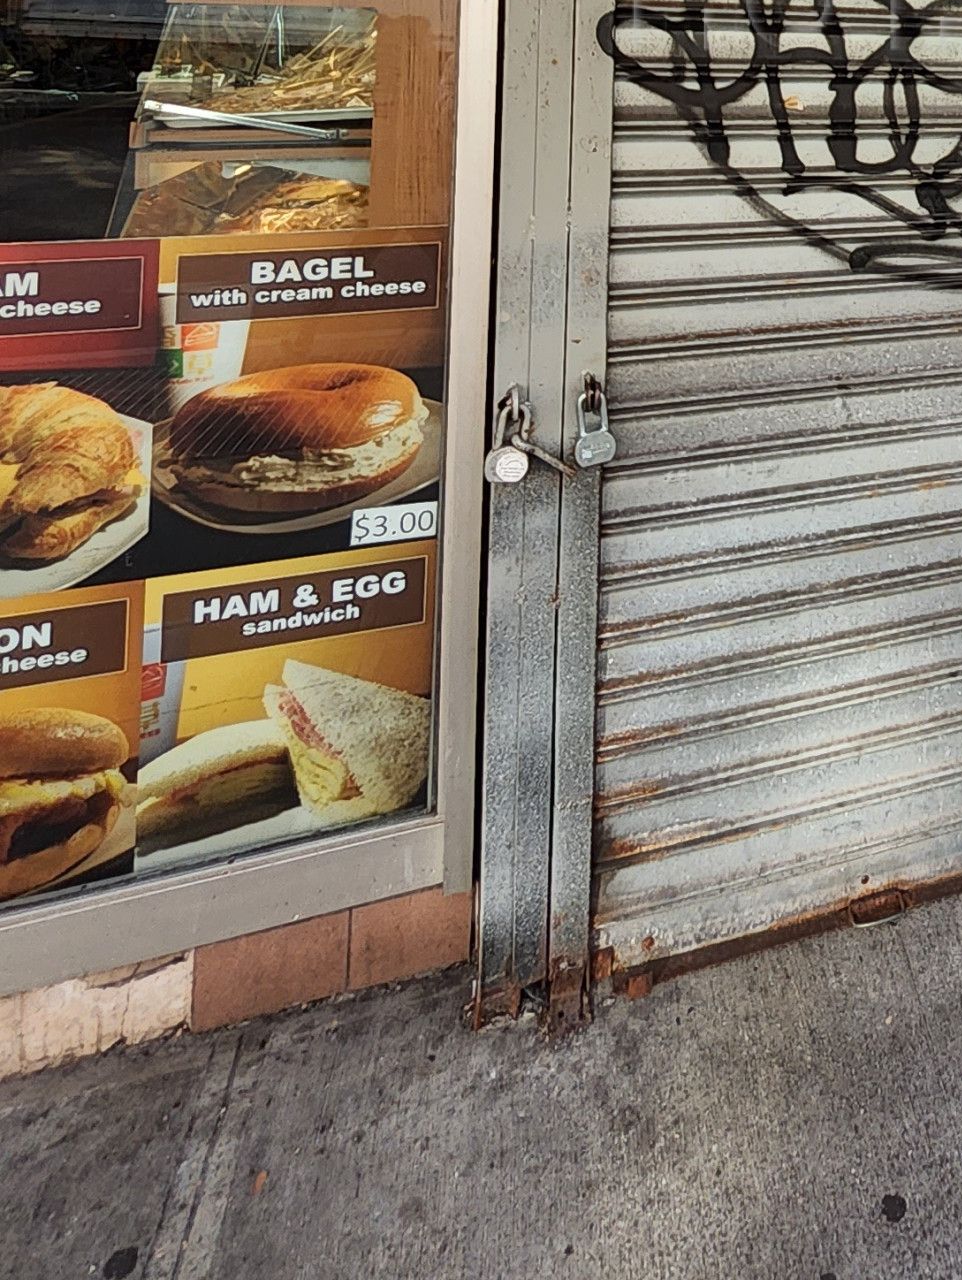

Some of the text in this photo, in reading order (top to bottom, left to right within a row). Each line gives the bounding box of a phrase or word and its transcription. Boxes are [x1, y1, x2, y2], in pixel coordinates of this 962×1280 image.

[250, 254, 375, 286] BAGEL
[190, 275, 427, 308] with cream cheese
[0, 299, 102, 319] cheese
[352, 506, 435, 541] $3.00
[193, 571, 406, 626] HAM & EGG
[242, 603, 361, 638] sandwich
